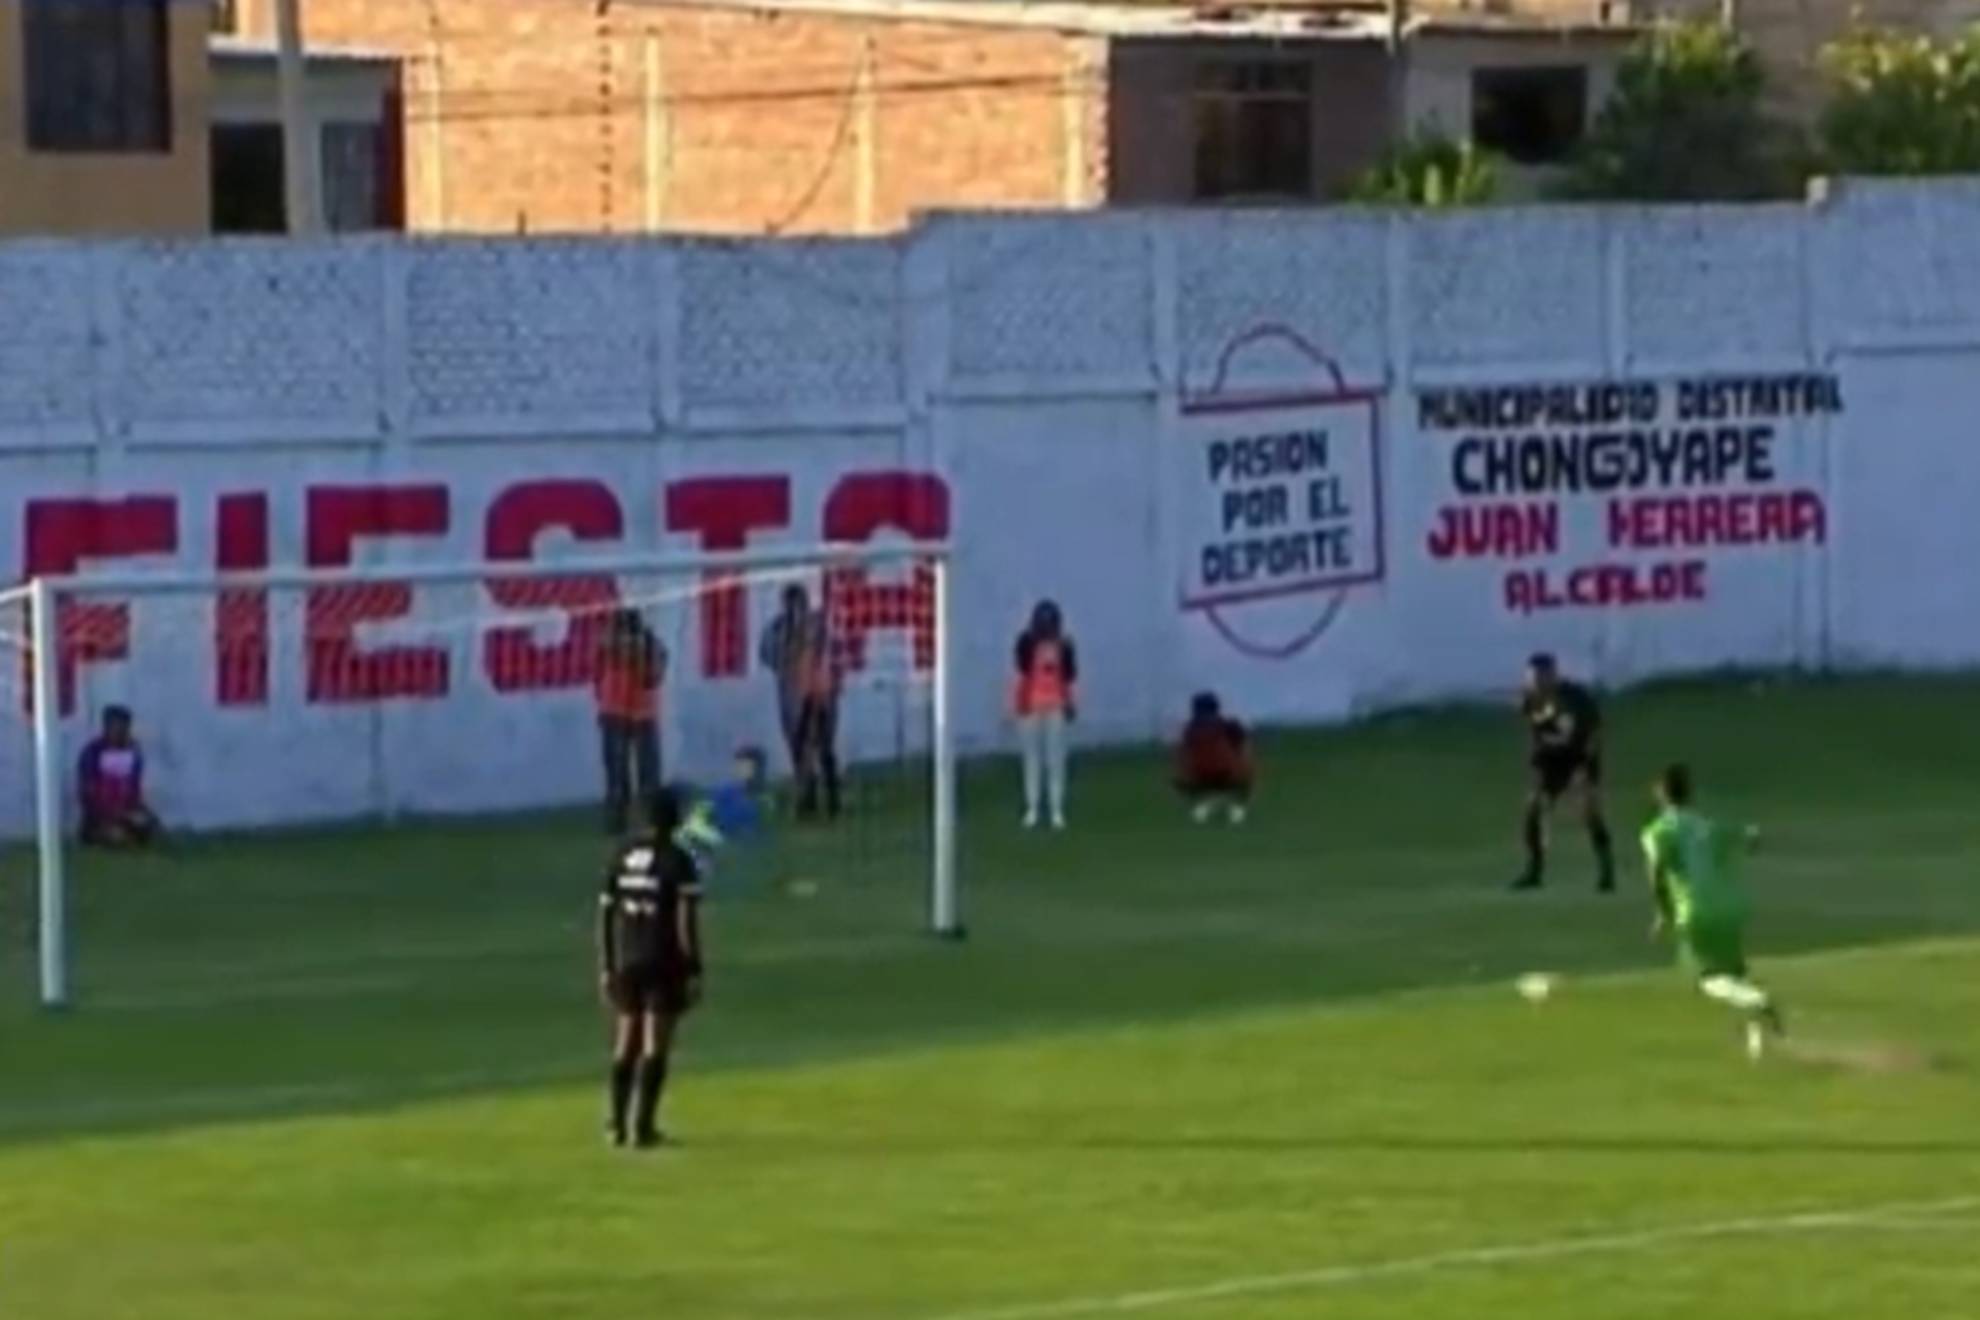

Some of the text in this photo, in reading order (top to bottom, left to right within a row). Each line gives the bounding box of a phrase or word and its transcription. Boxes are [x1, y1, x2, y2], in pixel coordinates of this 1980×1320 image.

[1208, 429, 1329, 484] PASION
[1453, 425, 1776, 495] CHONGOYAPE
[1223, 475, 1351, 534] POR EL
[1428, 489, 1826, 559] JUAN HERRERA
[1202, 525, 1352, 586] DEPORTE
[23, 470, 950, 717] FIESTA
[1505, 560, 1706, 617] ALCALDE
